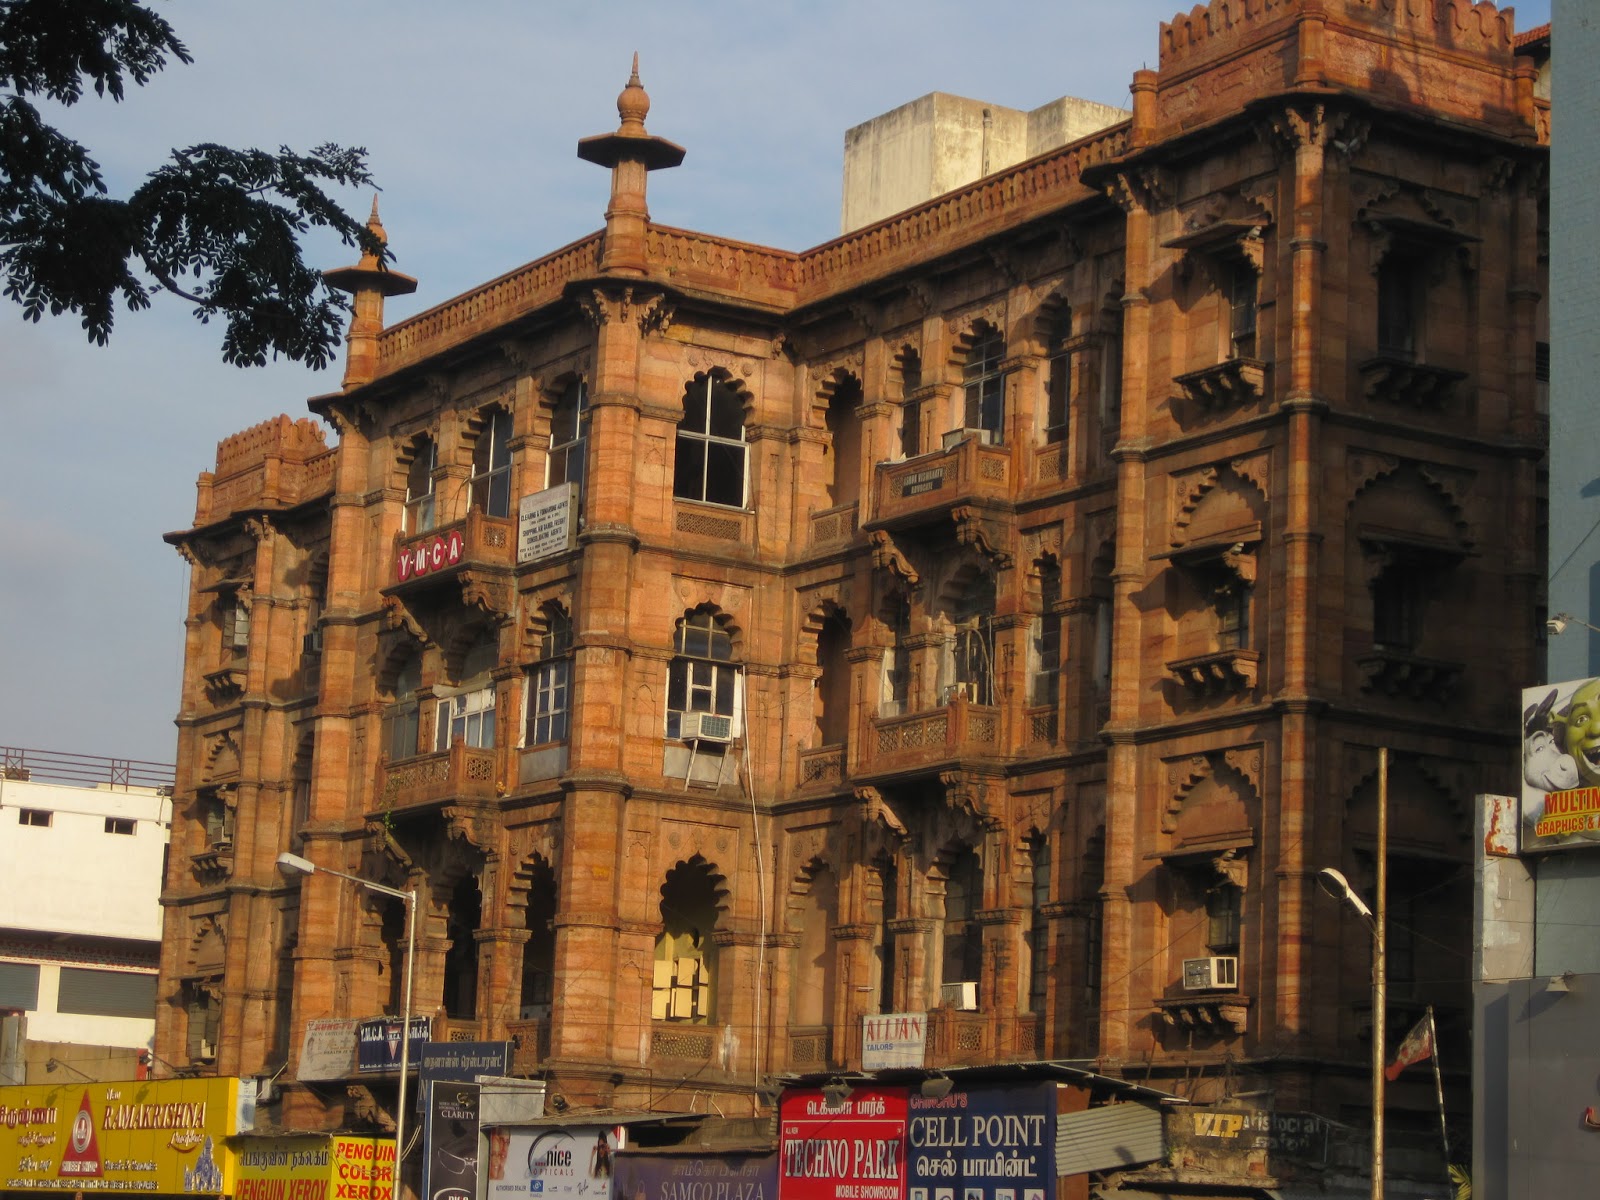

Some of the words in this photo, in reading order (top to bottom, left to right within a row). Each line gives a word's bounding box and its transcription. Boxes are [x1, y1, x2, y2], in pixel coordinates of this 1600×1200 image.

[1536, 816, 1584, 836] GRAPHICS
[1587, 816, 1594, 830] &
[866, 1043, 894, 1052] TAILORS
[102, 1102, 206, 1130] RAMAKRISHNA
[441, 1110, 475, 1119] CLARITY
[909, 1116, 967, 1147] CELL
[972, 1115, 1046, 1147] POINT
[335, 1142, 397, 1162] PENGUIN
[546, 1145, 572, 1167] nice
[784, 1138, 849, 1178] TECHNO
[853, 1138, 899, 1179] PARK
[338, 1163, 392, 1182] COLOR
[533, 1168, 574, 1176] OPTICALS
[916, 1150, 957, 1177] செல்
[963, 1149, 1038, 1177] பாயின்ட்
[236, 1178, 286, 1200] PENGUIN
[286, 1178, 329, 1200] XEROX
[335, 1183, 393, 1200] XEROX
[660, 1181, 713, 1200] SAMCO
[715, 1181, 764, 1200] PLAZA
[836, 1184, 859, 1198] MOBILE
[860, 1185, 899, 1199] SHOWROOM
